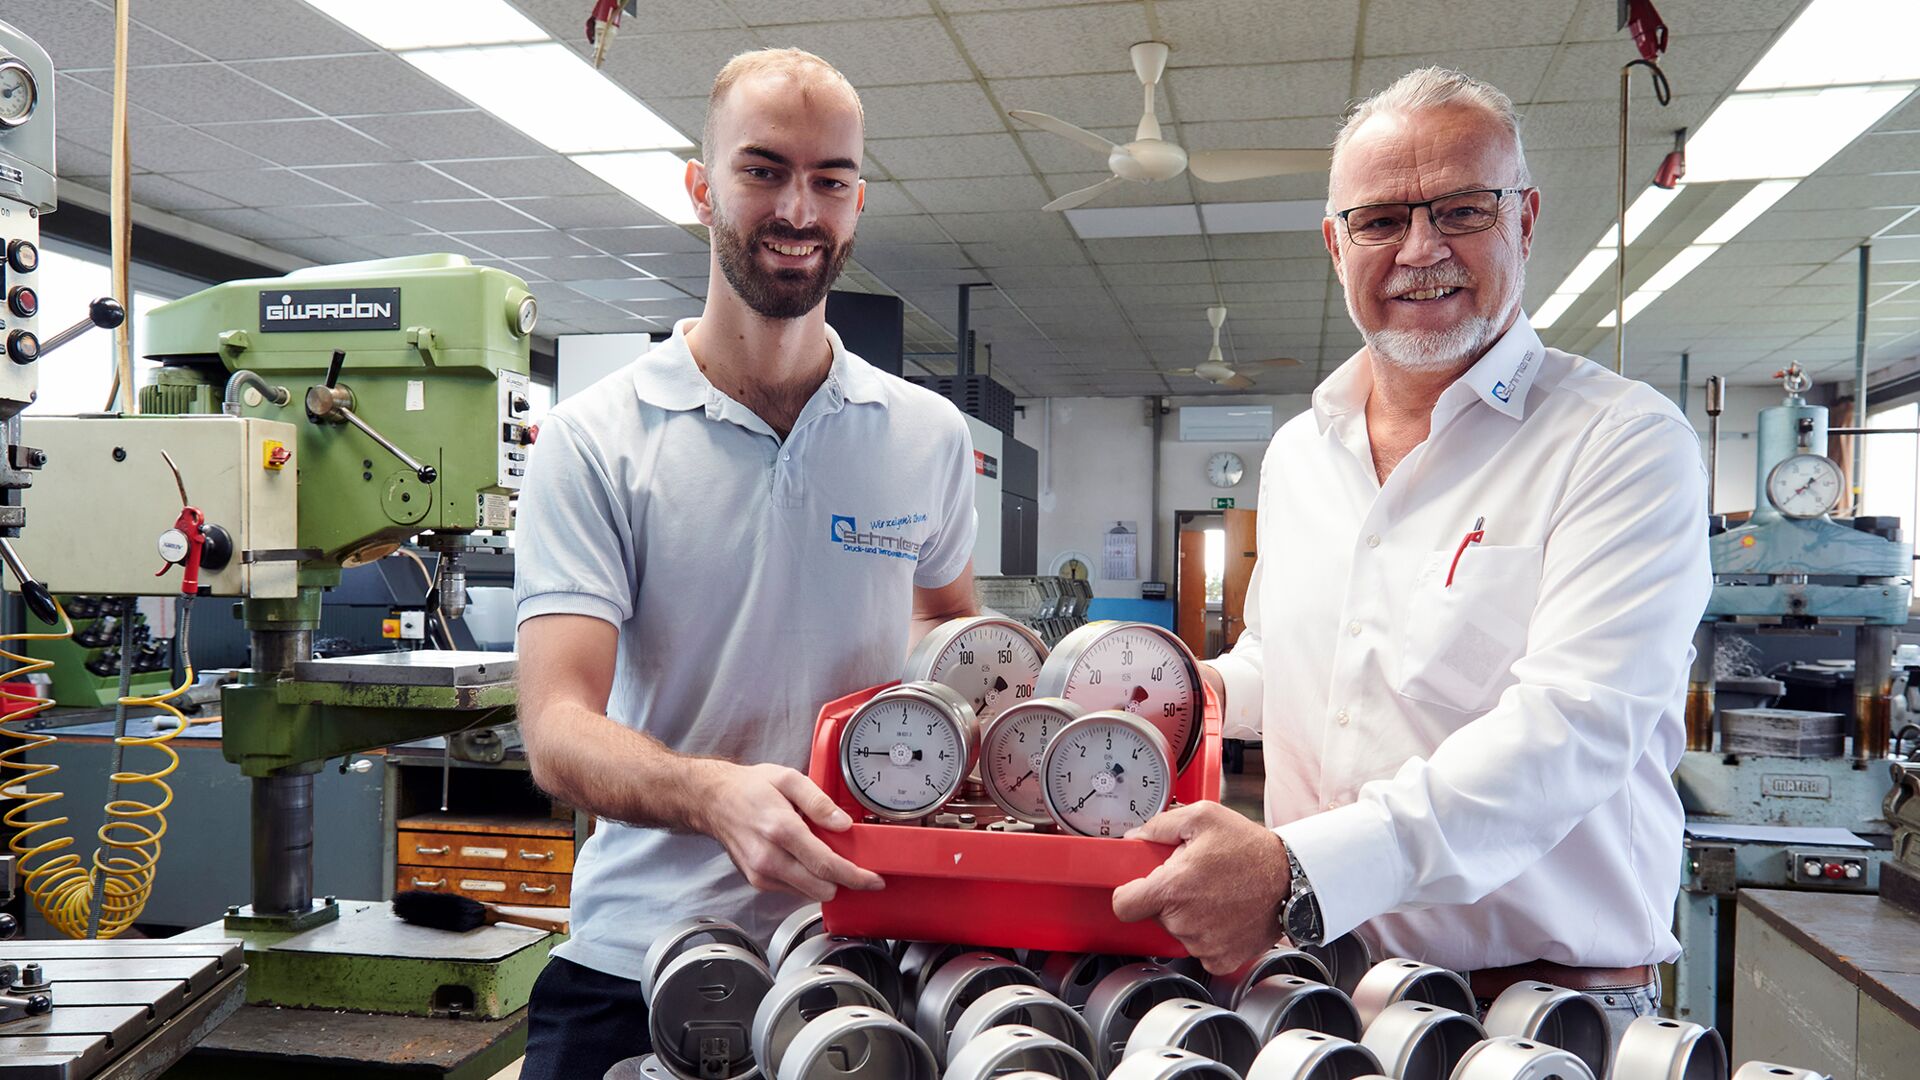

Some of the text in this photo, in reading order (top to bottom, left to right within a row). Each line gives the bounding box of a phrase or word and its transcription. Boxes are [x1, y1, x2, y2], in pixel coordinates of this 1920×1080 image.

[958, 651, 974, 665] 100
[997, 650, 1013, 664] 150
[1121, 650, 1133, 665] 30
[1089, 669, 1102, 685] 20
[1151, 666, 1163, 682] 40
[1015, 684, 1032, 699] 200
[1163, 702, 1176, 718] 50
[902, 713, 908, 725] 2
[877, 722, 881, 733] 1
[927, 724, 933, 736] 3
[1041, 726, 1047, 737] 3
[1019, 732, 1025, 743] 2
[1106, 738, 1112, 750] 3
[863, 746, 869, 758] 0
[938, 750, 944, 761] 4
[1080, 746, 1086, 758] 2
[1132, 749, 1138, 760] 4
[1008, 753, 1012, 764] 1
[925, 775, 931, 786] 5
[1067, 771, 1072, 783] 1
[1142, 776, 1148, 788] 5
[1129, 800, 1136, 811] 6
